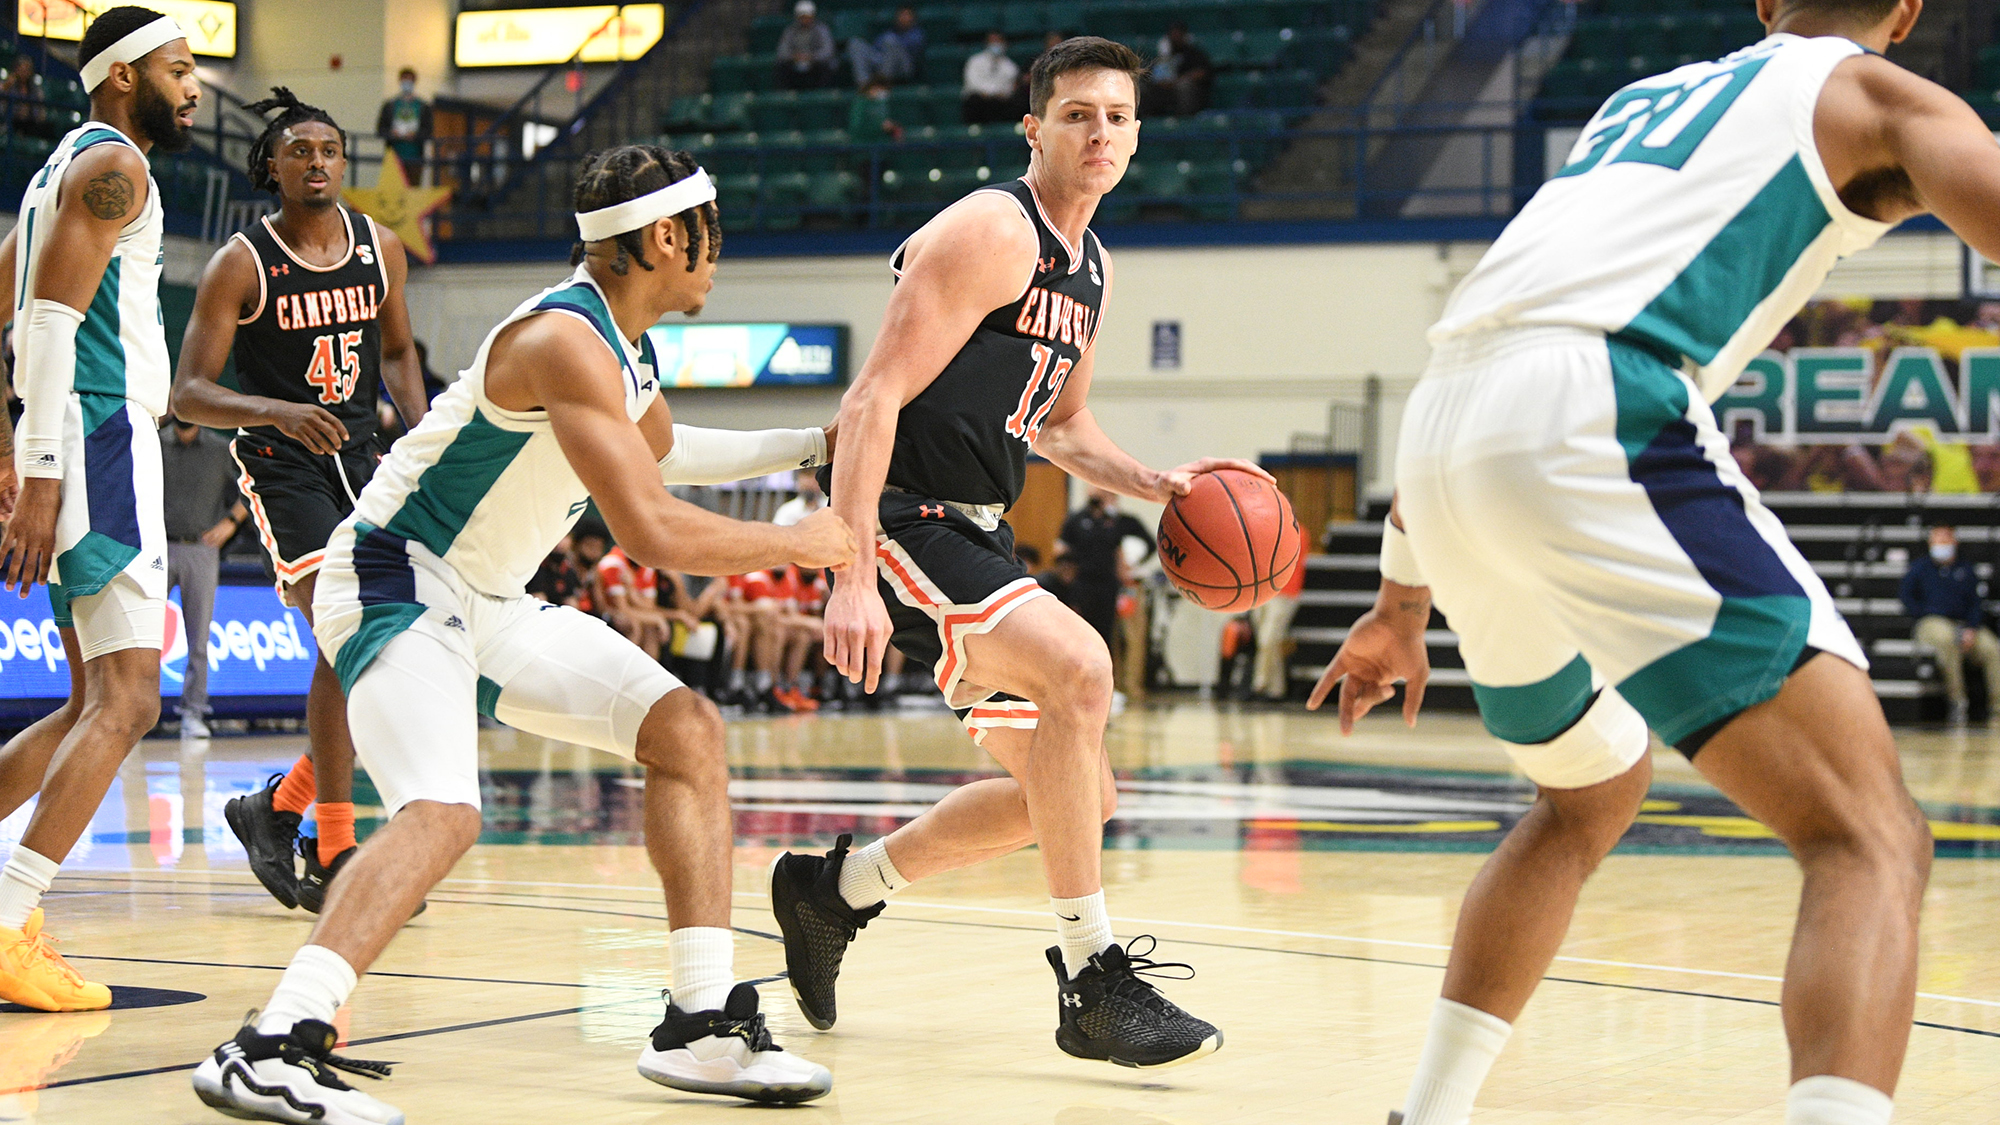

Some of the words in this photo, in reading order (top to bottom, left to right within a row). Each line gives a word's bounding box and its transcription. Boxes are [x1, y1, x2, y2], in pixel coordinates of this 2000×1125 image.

[1551, 54, 1775, 179] 30
[276, 283, 378, 331] CAMPBELL
[304, 328, 363, 405] 45
[1005, 341, 1073, 450] 12
[0, 618, 67, 673] pep
[206, 611, 304, 672] pepsi
